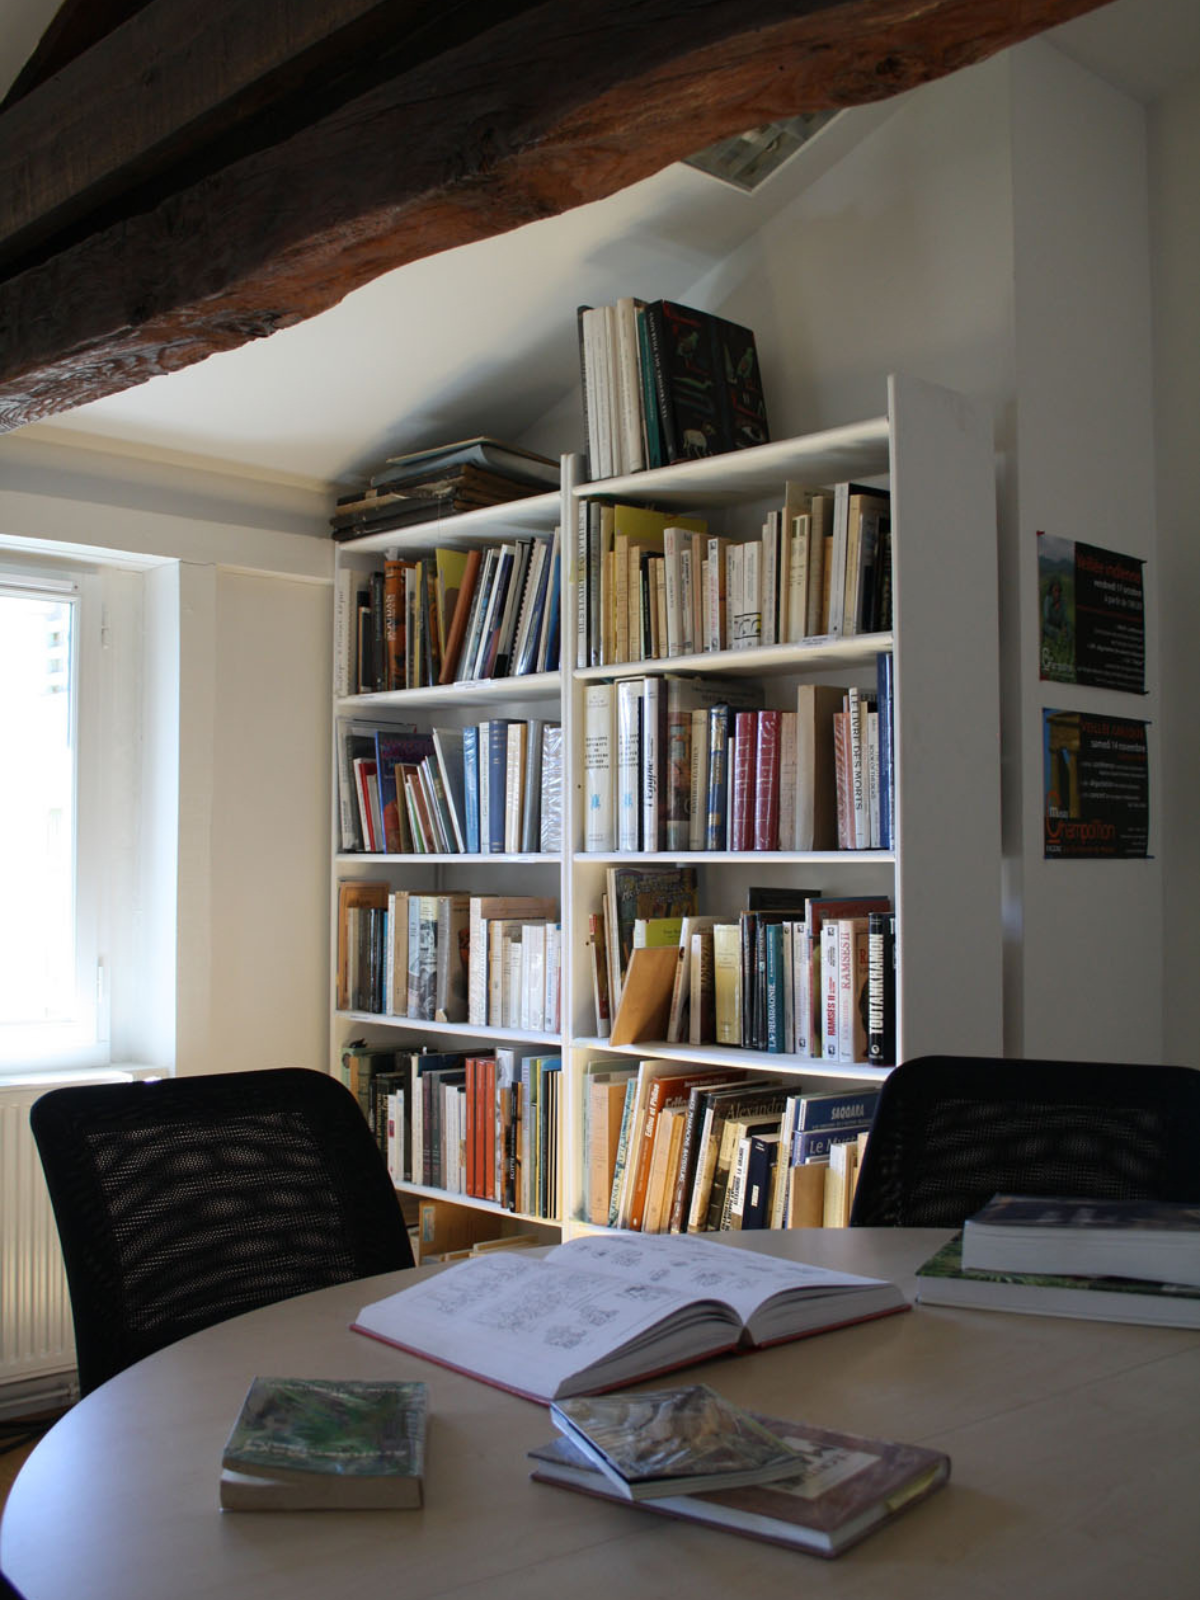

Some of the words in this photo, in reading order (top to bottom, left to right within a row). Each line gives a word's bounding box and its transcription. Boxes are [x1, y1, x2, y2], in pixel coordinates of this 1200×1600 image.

[855, 770, 863, 811] MORTS
[869, 934, 884, 1034] TOUTANKHAMON
[725, 1097, 785, 1119] Alexandri
[831, 1104, 865, 1120] SAQQARA
[809, 1140, 823, 1154] Le
